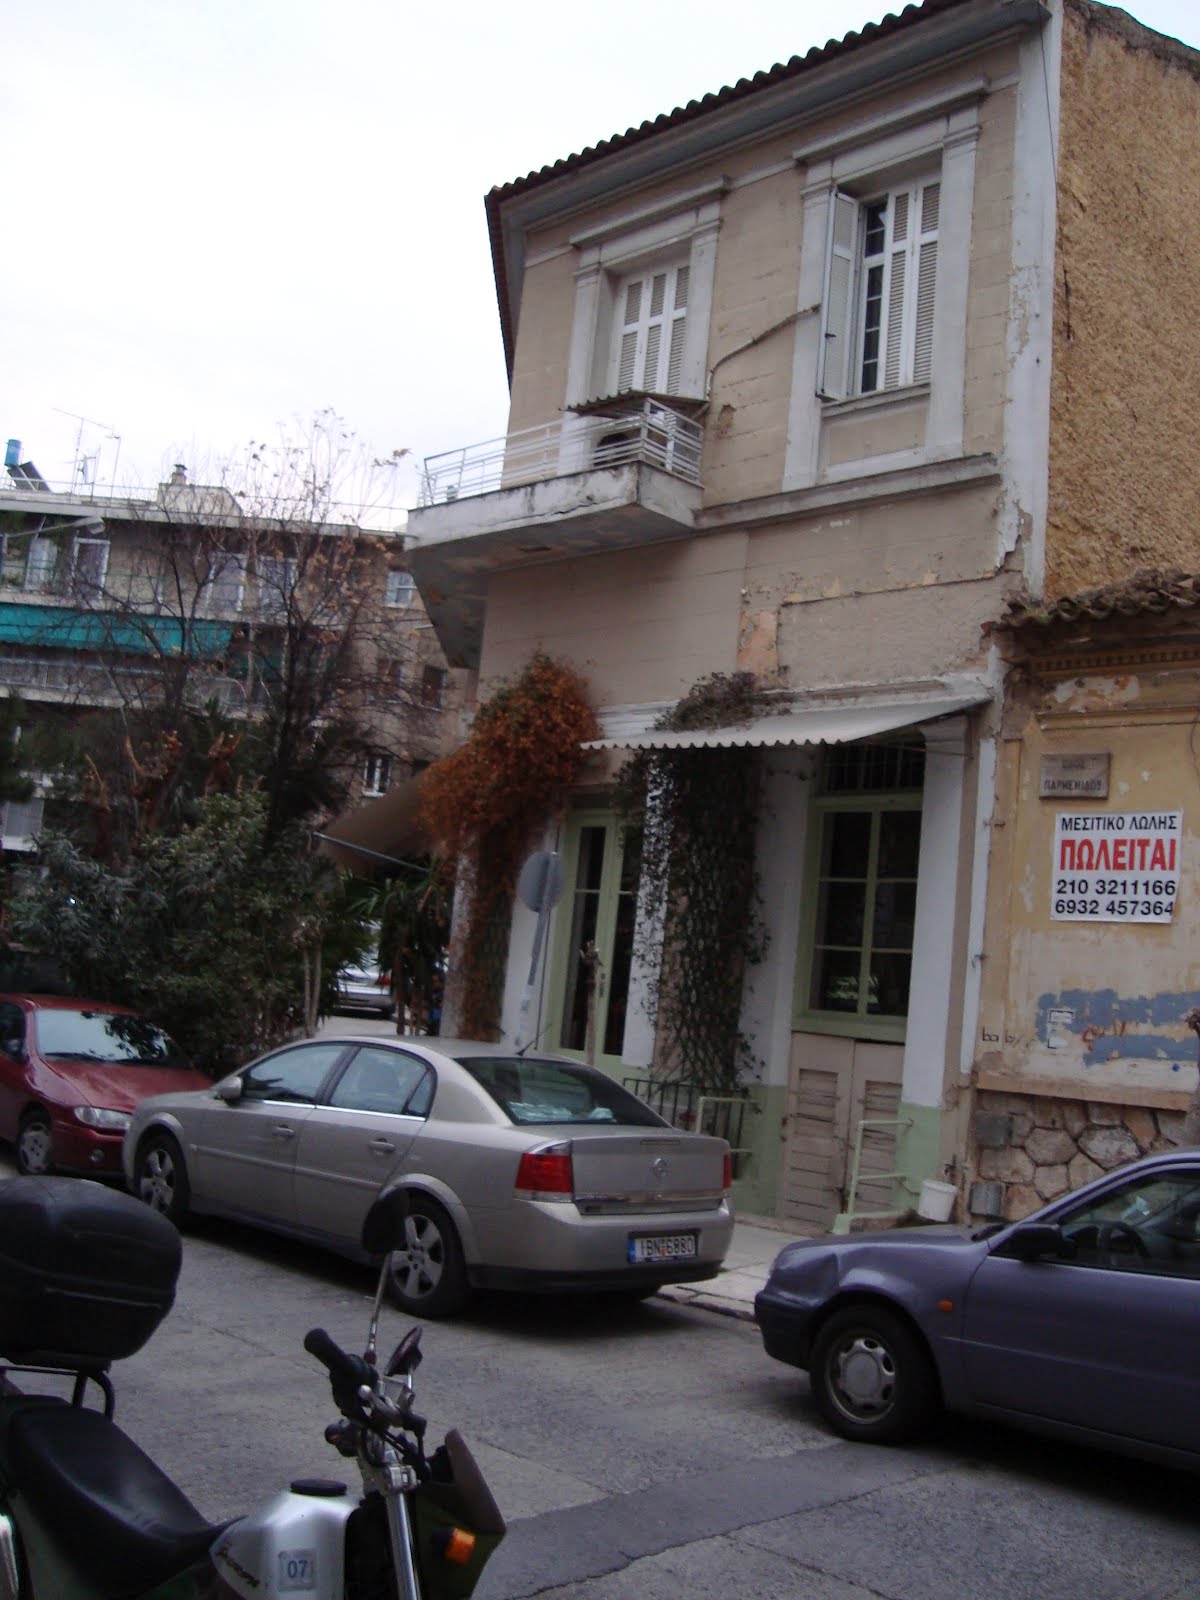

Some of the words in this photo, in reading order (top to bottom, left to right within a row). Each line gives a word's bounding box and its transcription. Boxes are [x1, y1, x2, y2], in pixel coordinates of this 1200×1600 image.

[1061, 816, 1125, 831] ΜΕΣΙΤΙΚΟ
[1130, 815, 1177, 830] ΛΩΛΗΣ
[1060, 838, 1177, 871] ΠΩΛΕΙΤΑΙ
[1056, 879, 1089, 894] 210
[1095, 880, 1176, 895] 3211166
[1055, 899, 1100, 914] 6932
[1105, 901, 1174, 915] 457364
[287, 1559, 309, 1578] 07
